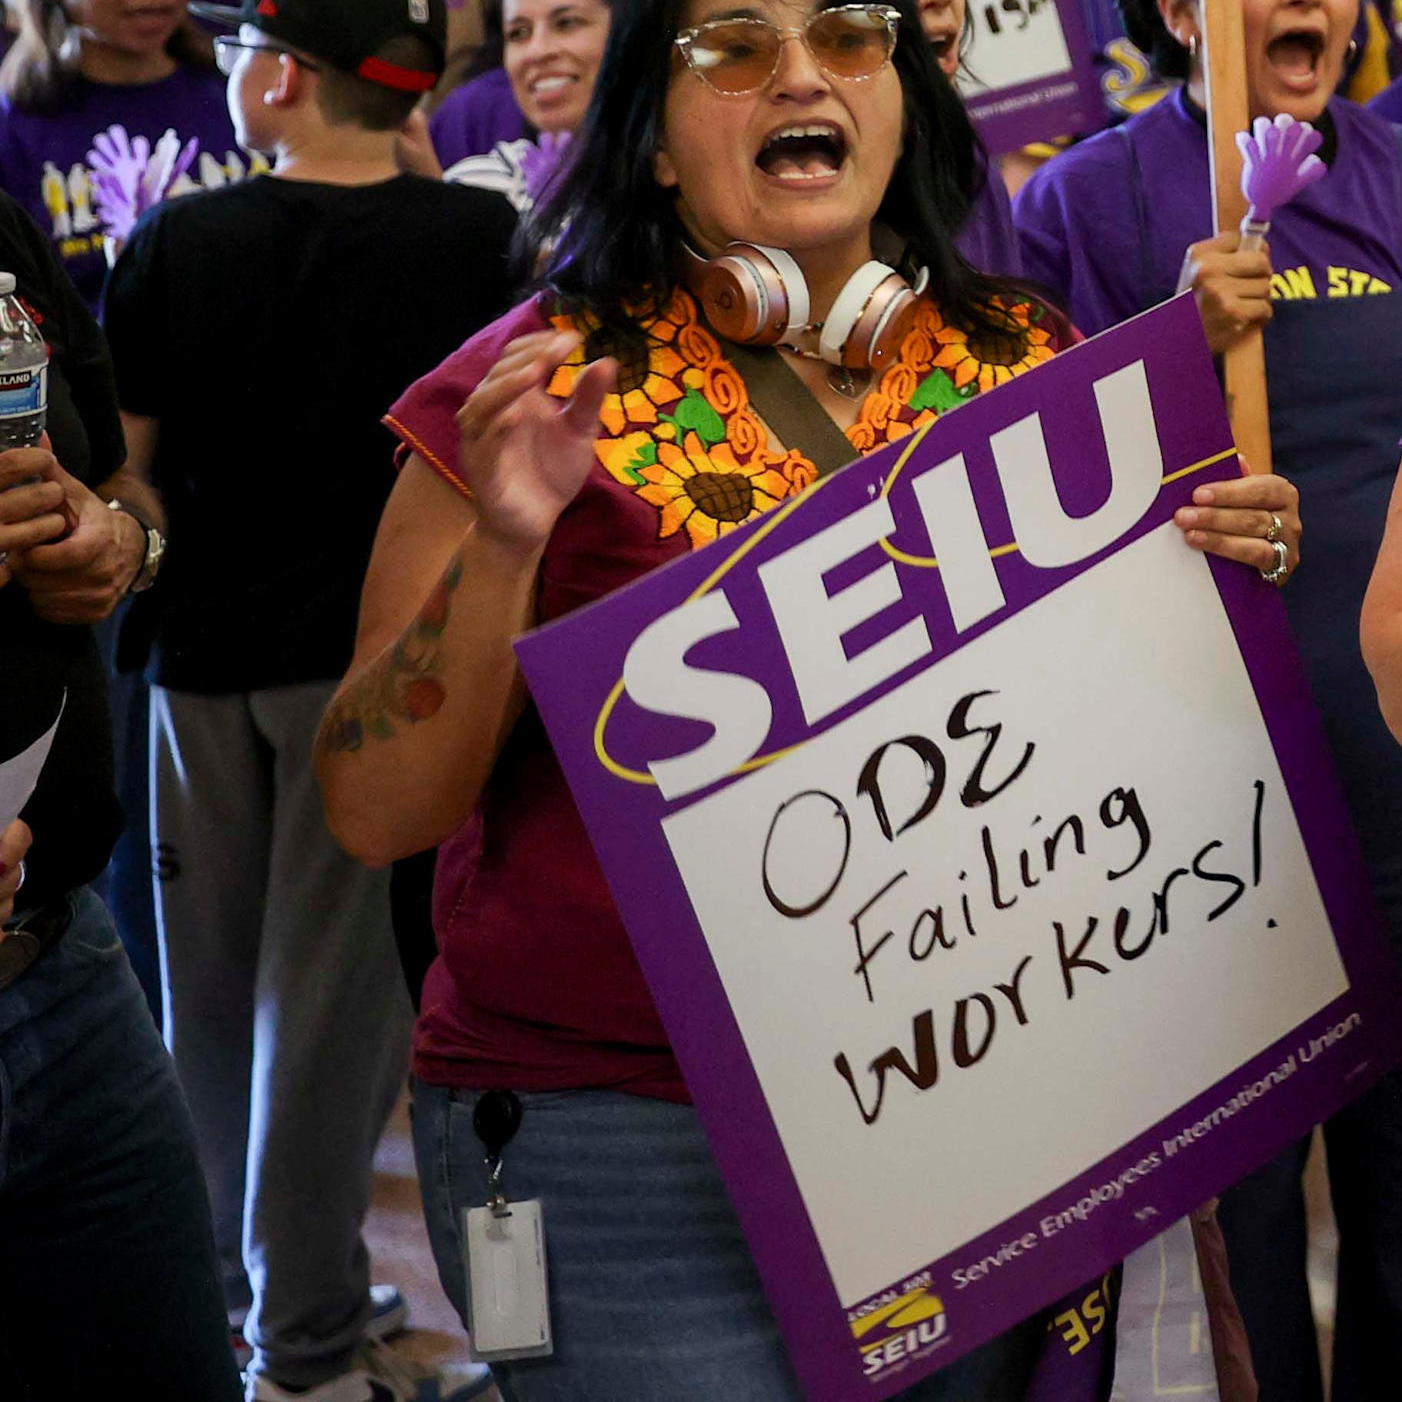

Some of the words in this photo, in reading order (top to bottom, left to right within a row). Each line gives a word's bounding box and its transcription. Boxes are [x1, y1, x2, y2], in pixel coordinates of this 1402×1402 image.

[0, 373, 31, 385] LAND
[622, 359, 1167, 801] SEIU
[762, 690, 1036, 918] ODE
[850, 786, 1151, 1003] Failing
[952, 1232, 1038, 1289] Service
[1040, 1151, 1162, 1239] Employees
[1162, 1054, 1298, 1157] International
[1300, 1011, 1361, 1064] Union
[863, 1313, 946, 1375] SEIU
